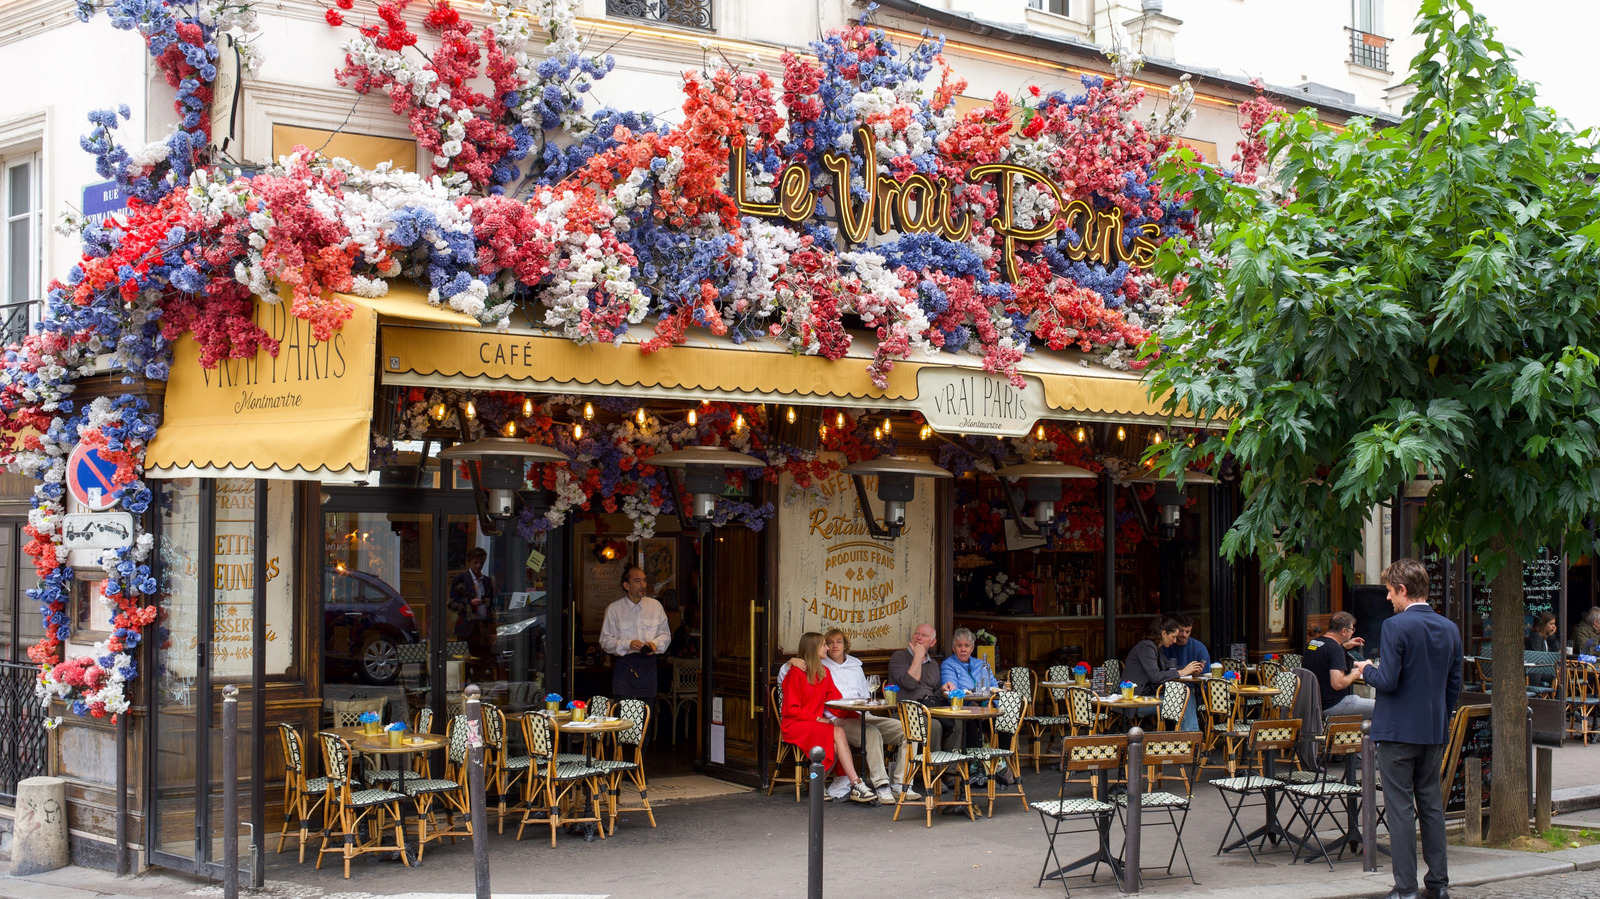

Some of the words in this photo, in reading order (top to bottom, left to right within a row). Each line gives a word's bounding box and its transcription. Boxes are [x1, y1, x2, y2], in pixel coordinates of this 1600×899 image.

[103, 188, 119, 202] RUE
[729, 142, 817, 222] Le
[819, 123, 973, 245] Vrai
[965, 164, 1161, 284] Paris
[271, 300, 346, 384] PARIS
[479, 341, 532, 367] CAFÉ
[234, 390, 303, 414] Montmartre
[934, 376, 974, 417] VRAI
[984, 376, 1027, 421] PARIS
[958, 417, 1003, 430] Montmartre
[215, 534, 255, 556] ETIT
[825, 550, 869, 572] PRODUITS
[870, 551, 896, 571] FRAIS
[856, 567, 865, 582] &
[825, 579, 850, 602] FAIT
[852, 578, 894, 603] MAISON
[821, 602, 865, 624] TOUTE
[867, 594, 909, 622] HEURE
[214, 618, 254, 634] ESSERT
